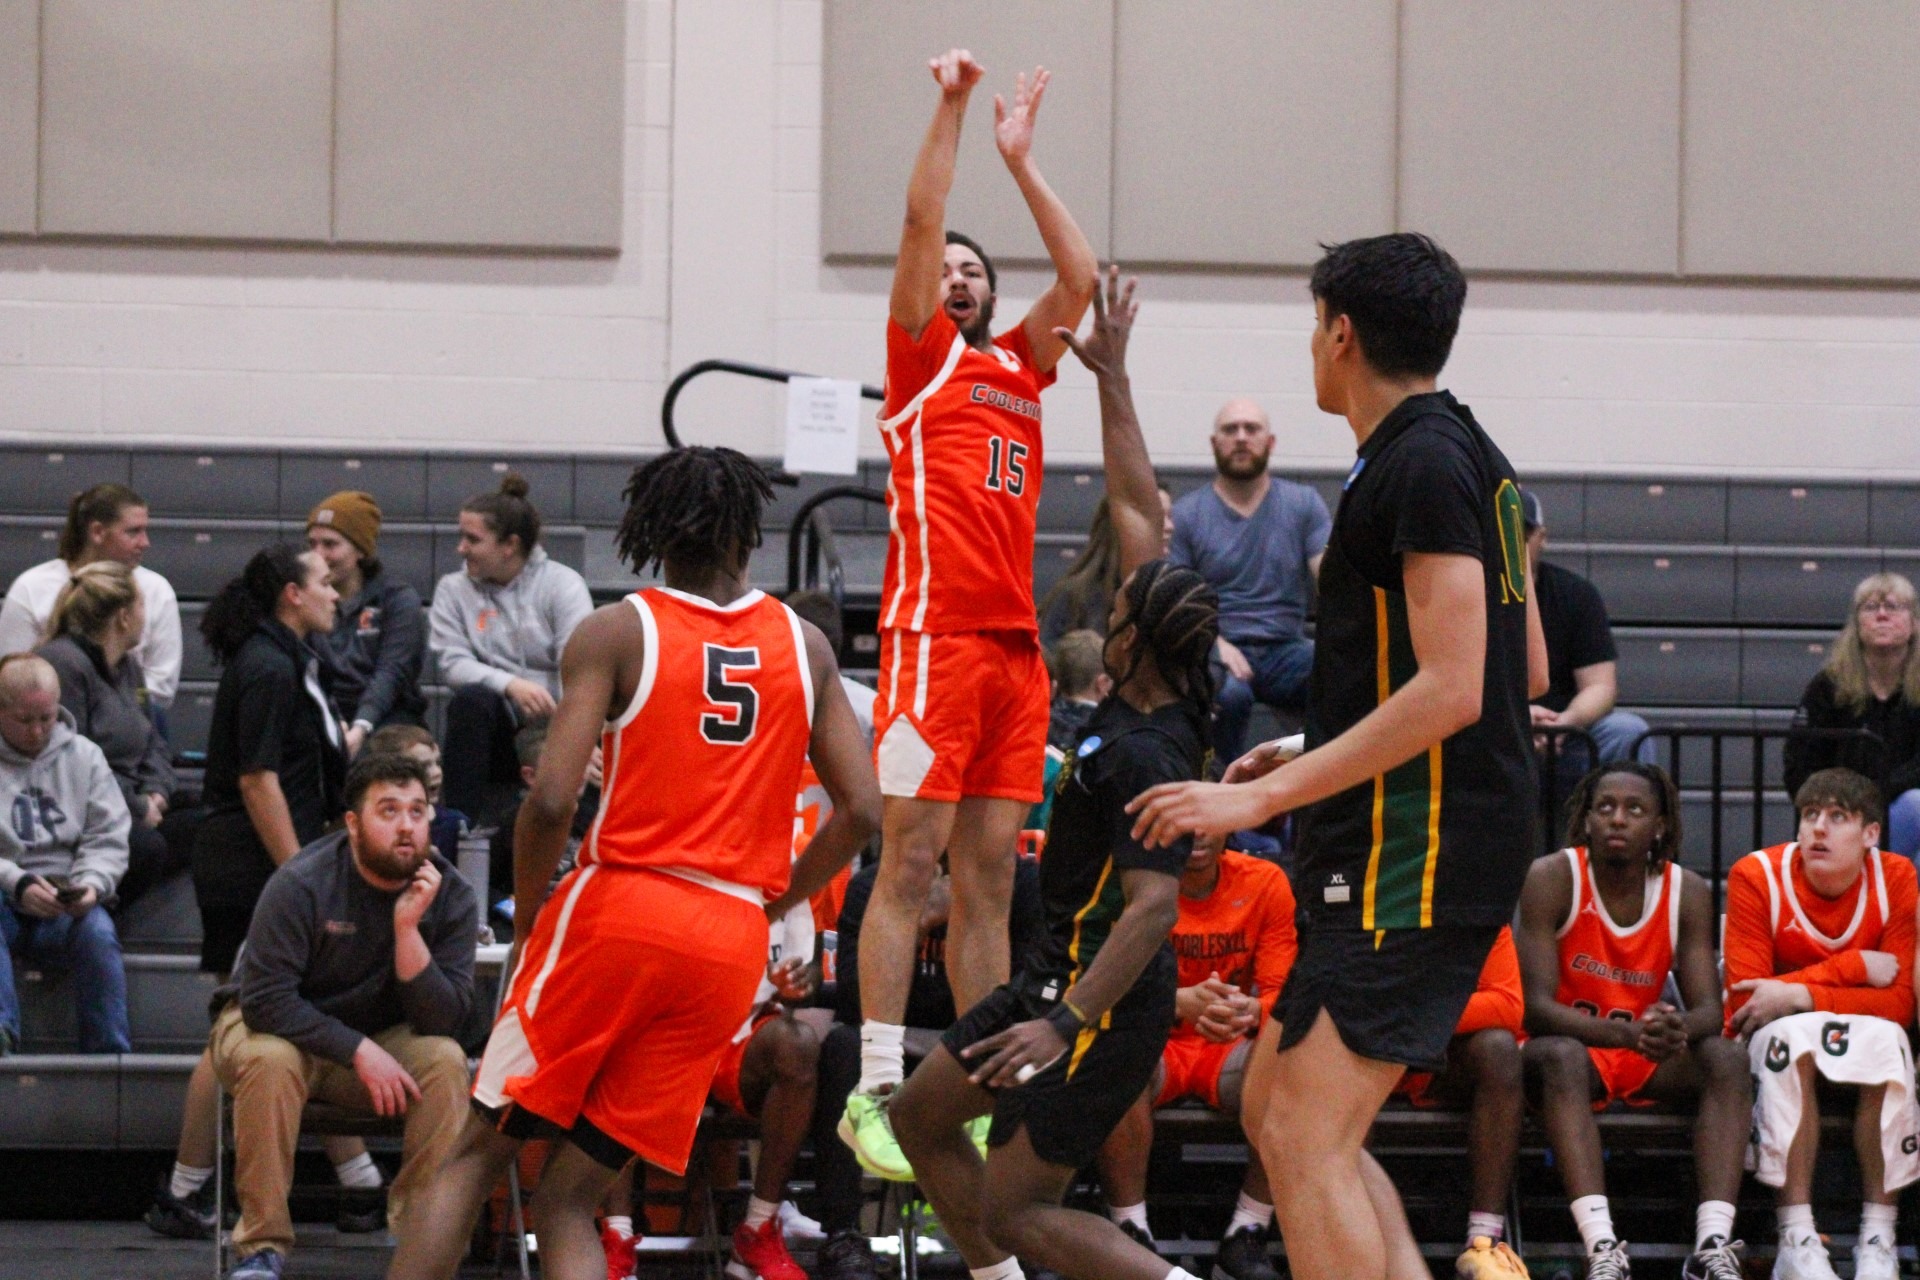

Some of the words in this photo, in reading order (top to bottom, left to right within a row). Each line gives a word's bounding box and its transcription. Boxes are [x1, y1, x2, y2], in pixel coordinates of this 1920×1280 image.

[971, 384, 1042, 421] COBLESK
[986, 436, 1029, 497] 15
[1495, 479, 1525, 604] 0
[699, 641, 761, 746] 5
[1330, 873, 1346, 885] XL
[1821, 1021, 1850, 1057] G
